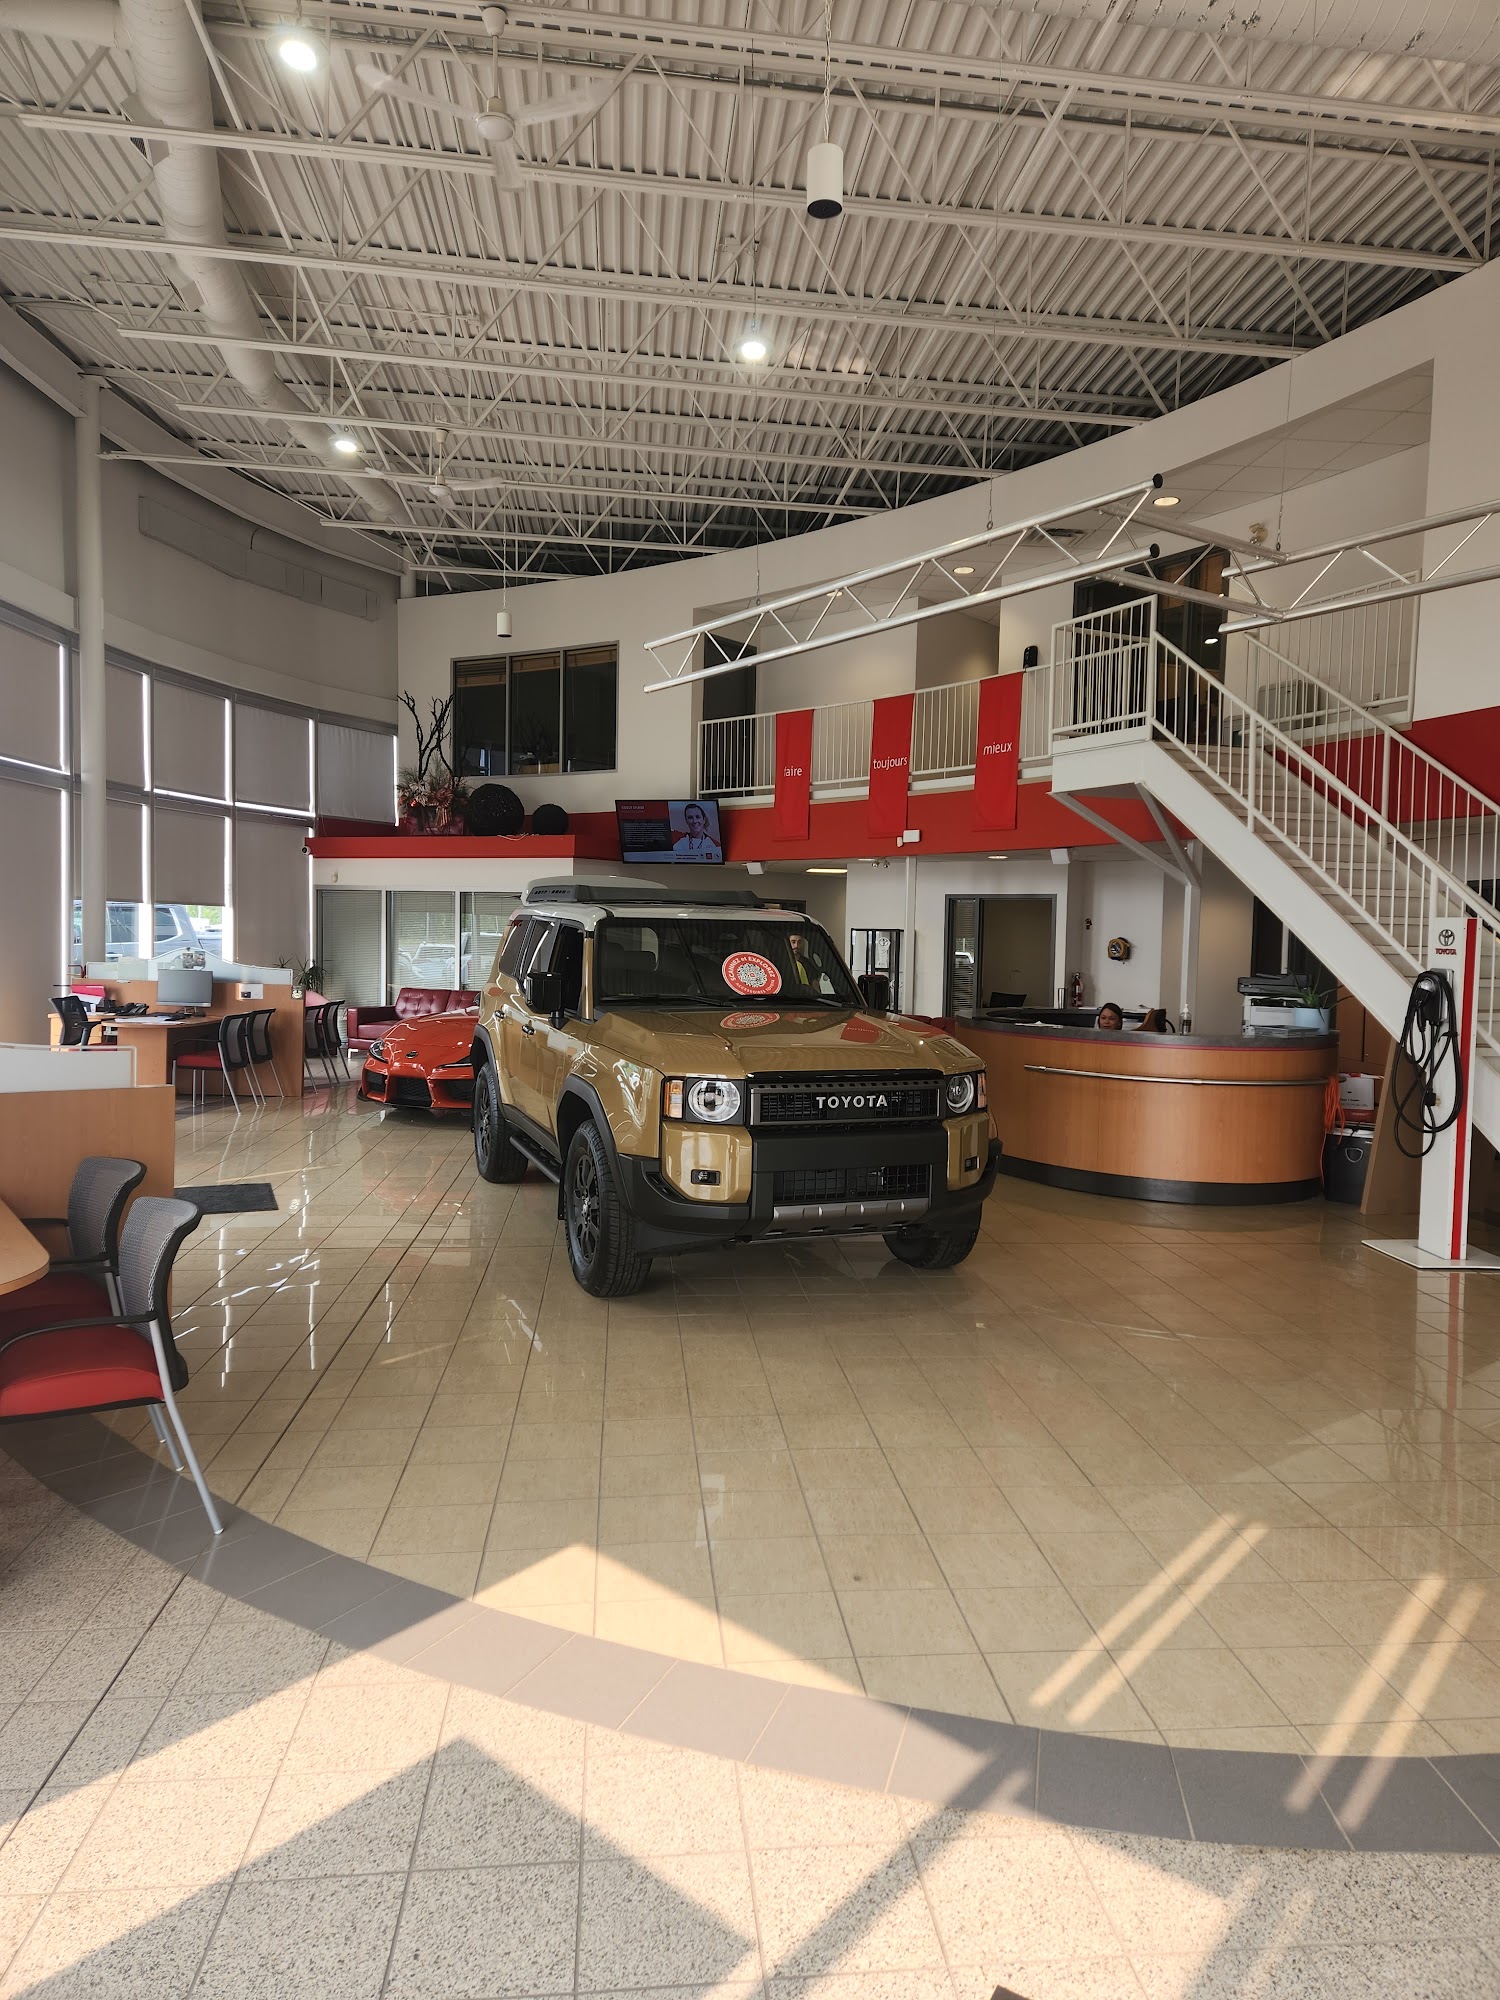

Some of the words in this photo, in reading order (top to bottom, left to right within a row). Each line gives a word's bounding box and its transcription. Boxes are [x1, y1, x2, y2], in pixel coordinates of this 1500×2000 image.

[982, 741, 1013, 756] mieux
[872, 755, 908, 771] toujours
[1435, 948, 1457, 956] TOYOTA
[748, 957, 776, 978] EXPLOREZ
[816, 1094, 888, 1109] TOYOTA
